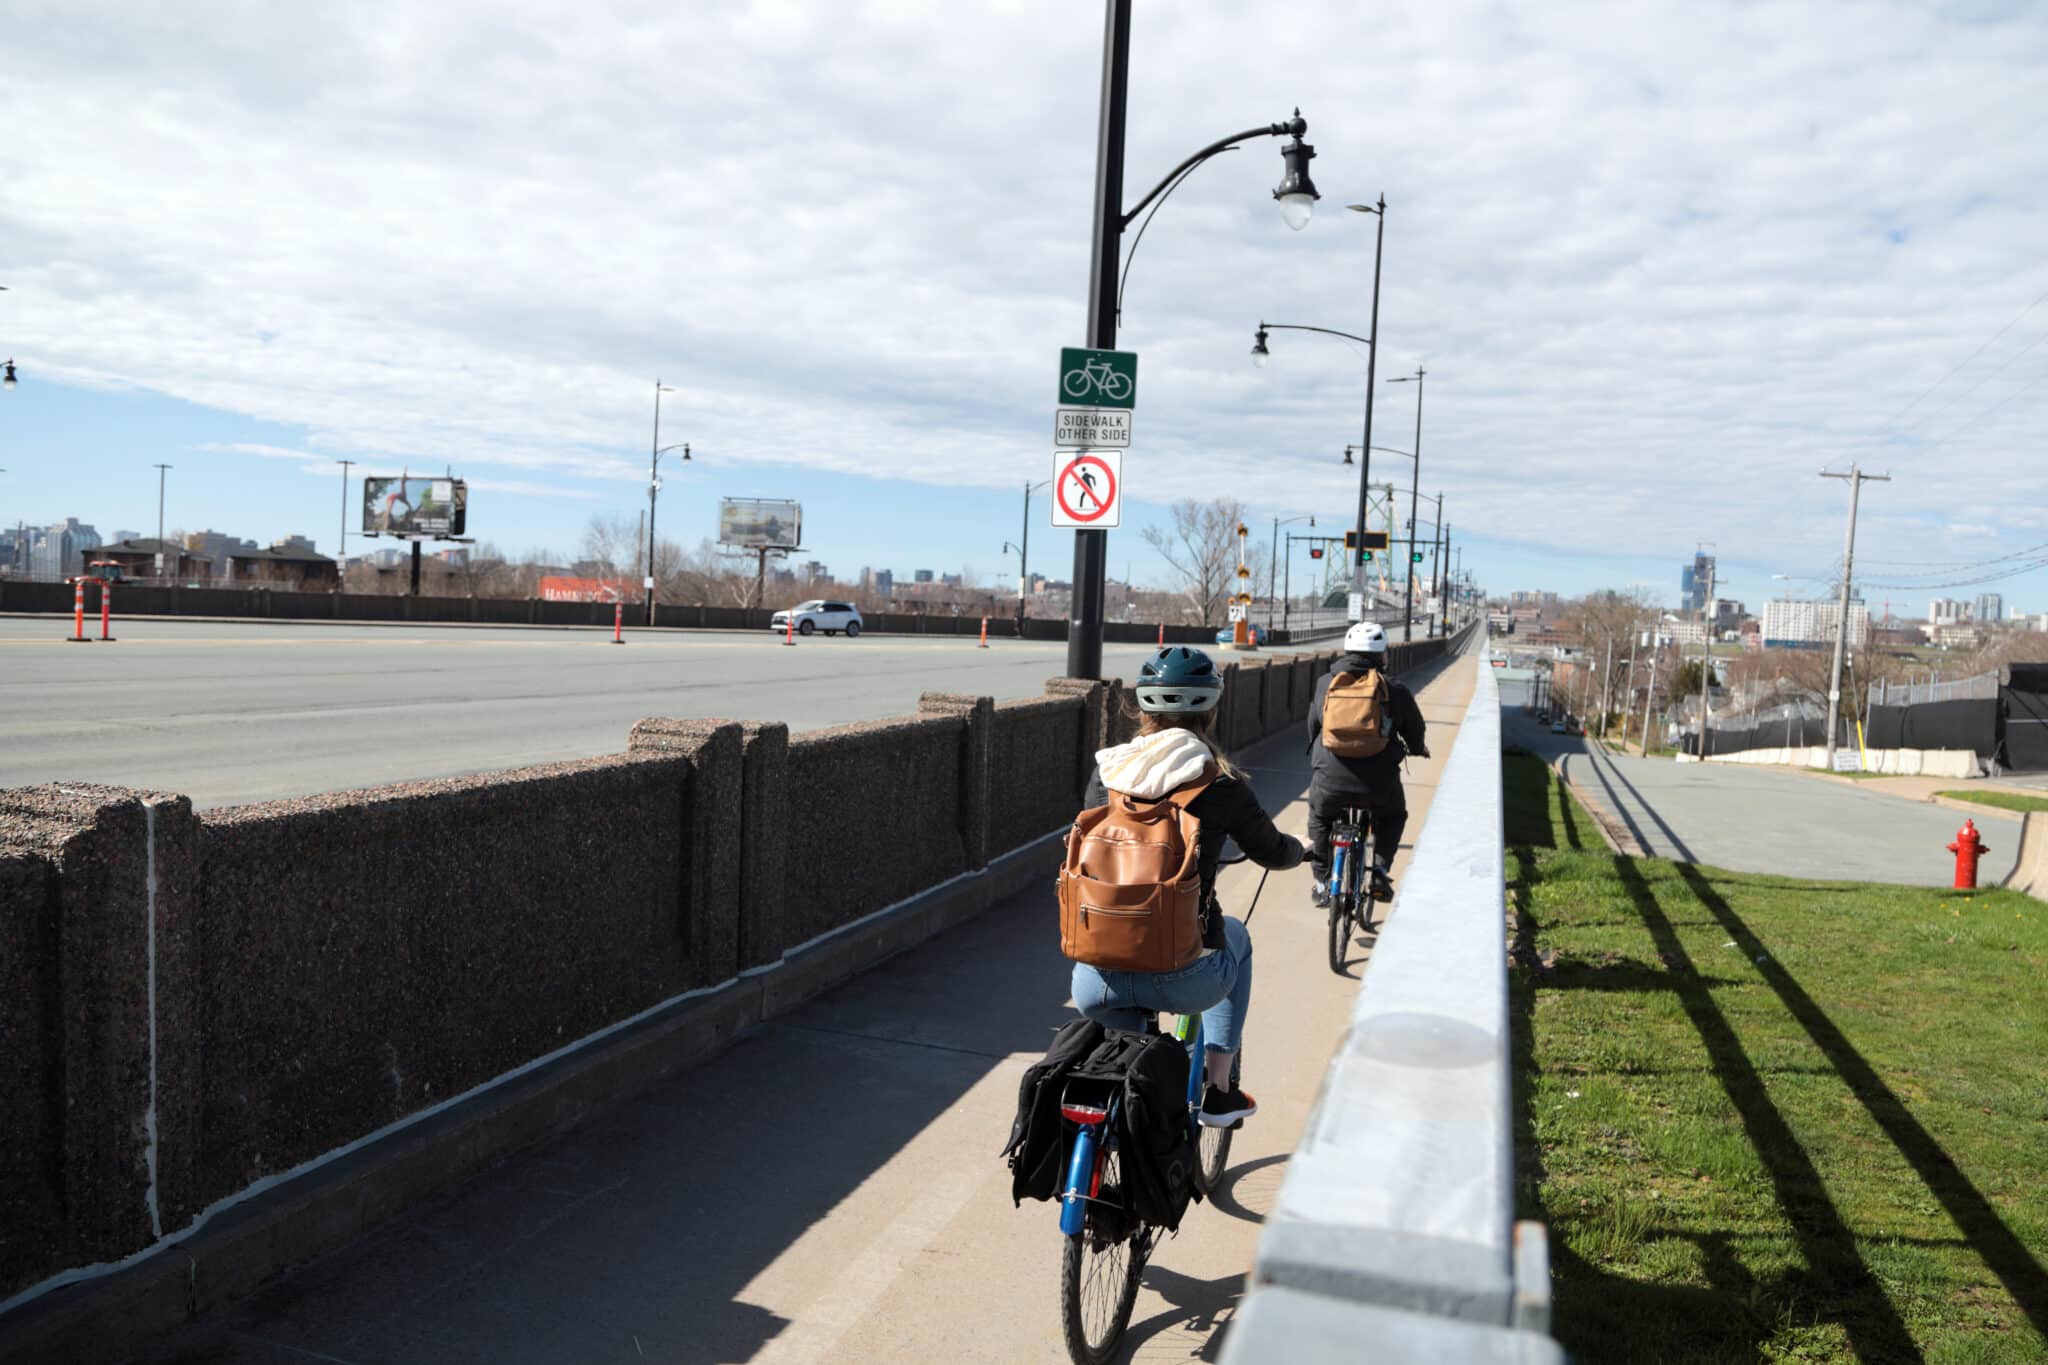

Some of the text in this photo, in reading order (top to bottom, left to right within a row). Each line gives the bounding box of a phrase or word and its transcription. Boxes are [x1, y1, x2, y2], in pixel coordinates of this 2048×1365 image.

[1064, 415, 1123, 427] SIDEWALK
[1059, 428, 1128, 441] OTHER SIDE
